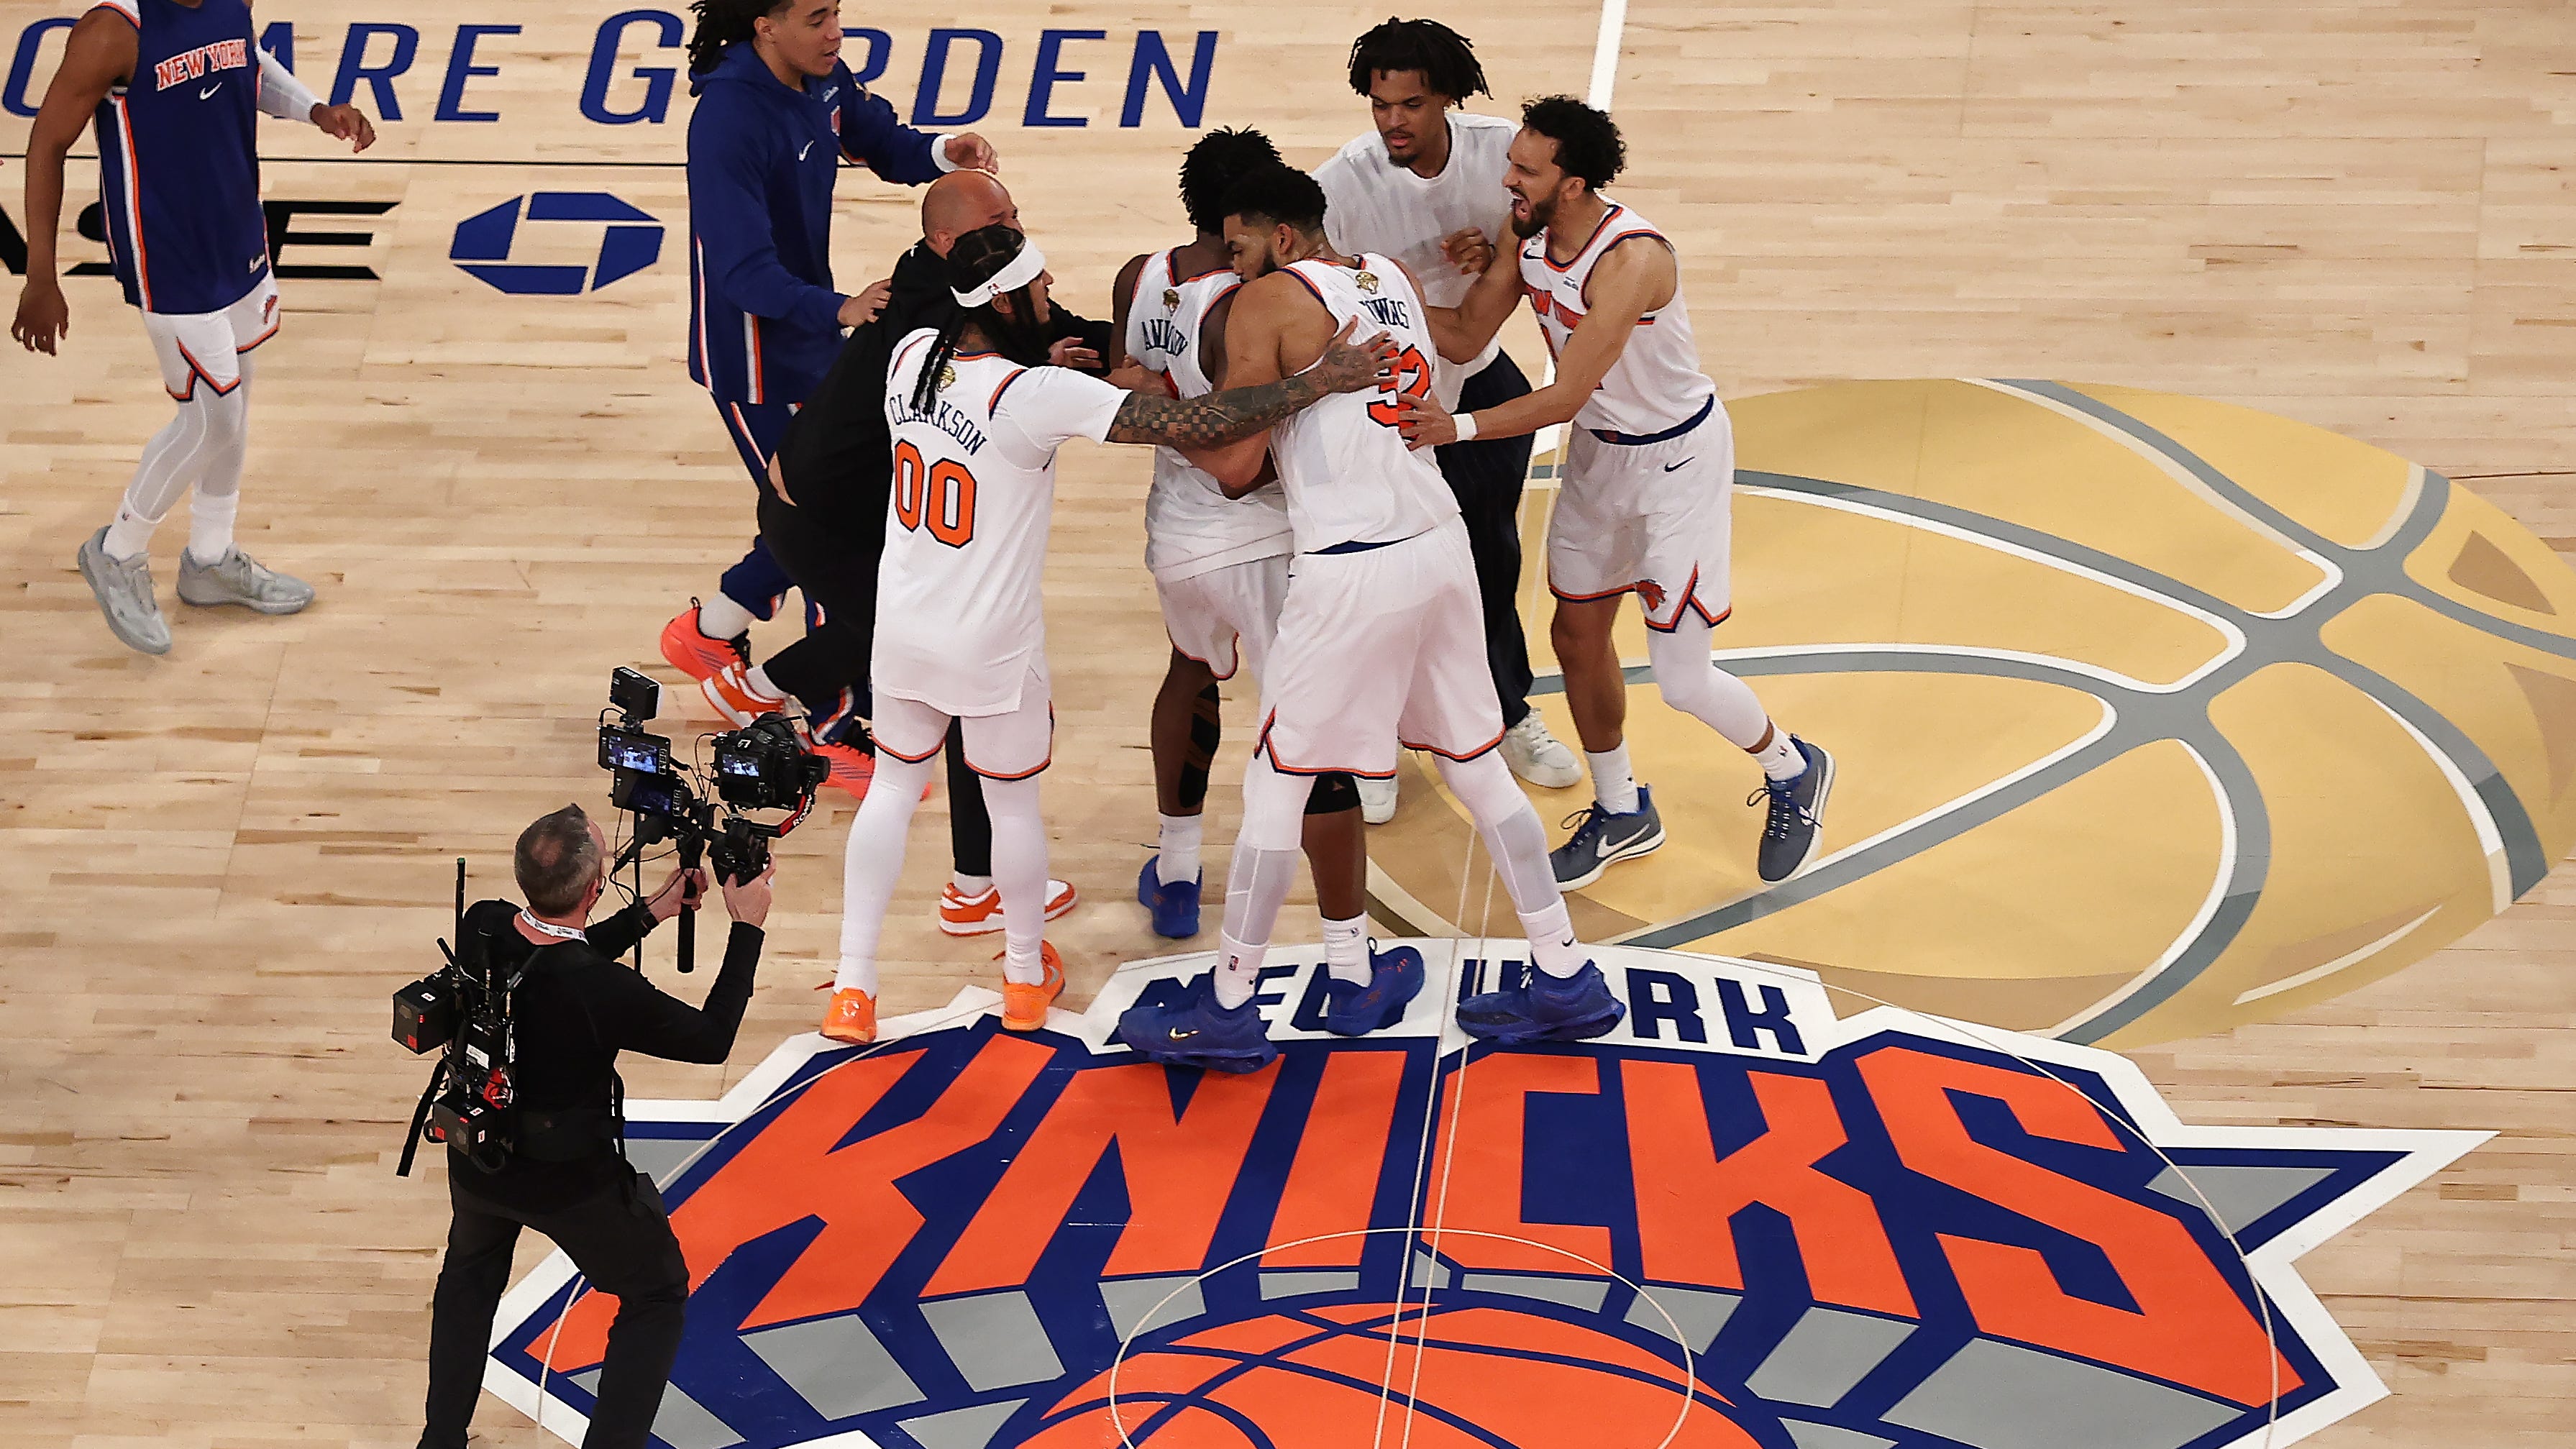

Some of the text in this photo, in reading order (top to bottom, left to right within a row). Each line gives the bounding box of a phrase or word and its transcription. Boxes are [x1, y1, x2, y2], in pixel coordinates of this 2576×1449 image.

[155, 38, 247, 91] NEW YORK
[580, 9, 1218, 127] GDEN
[895, 438, 977, 549] 00
[524, 1043, 2305, 1411] KNICKS
